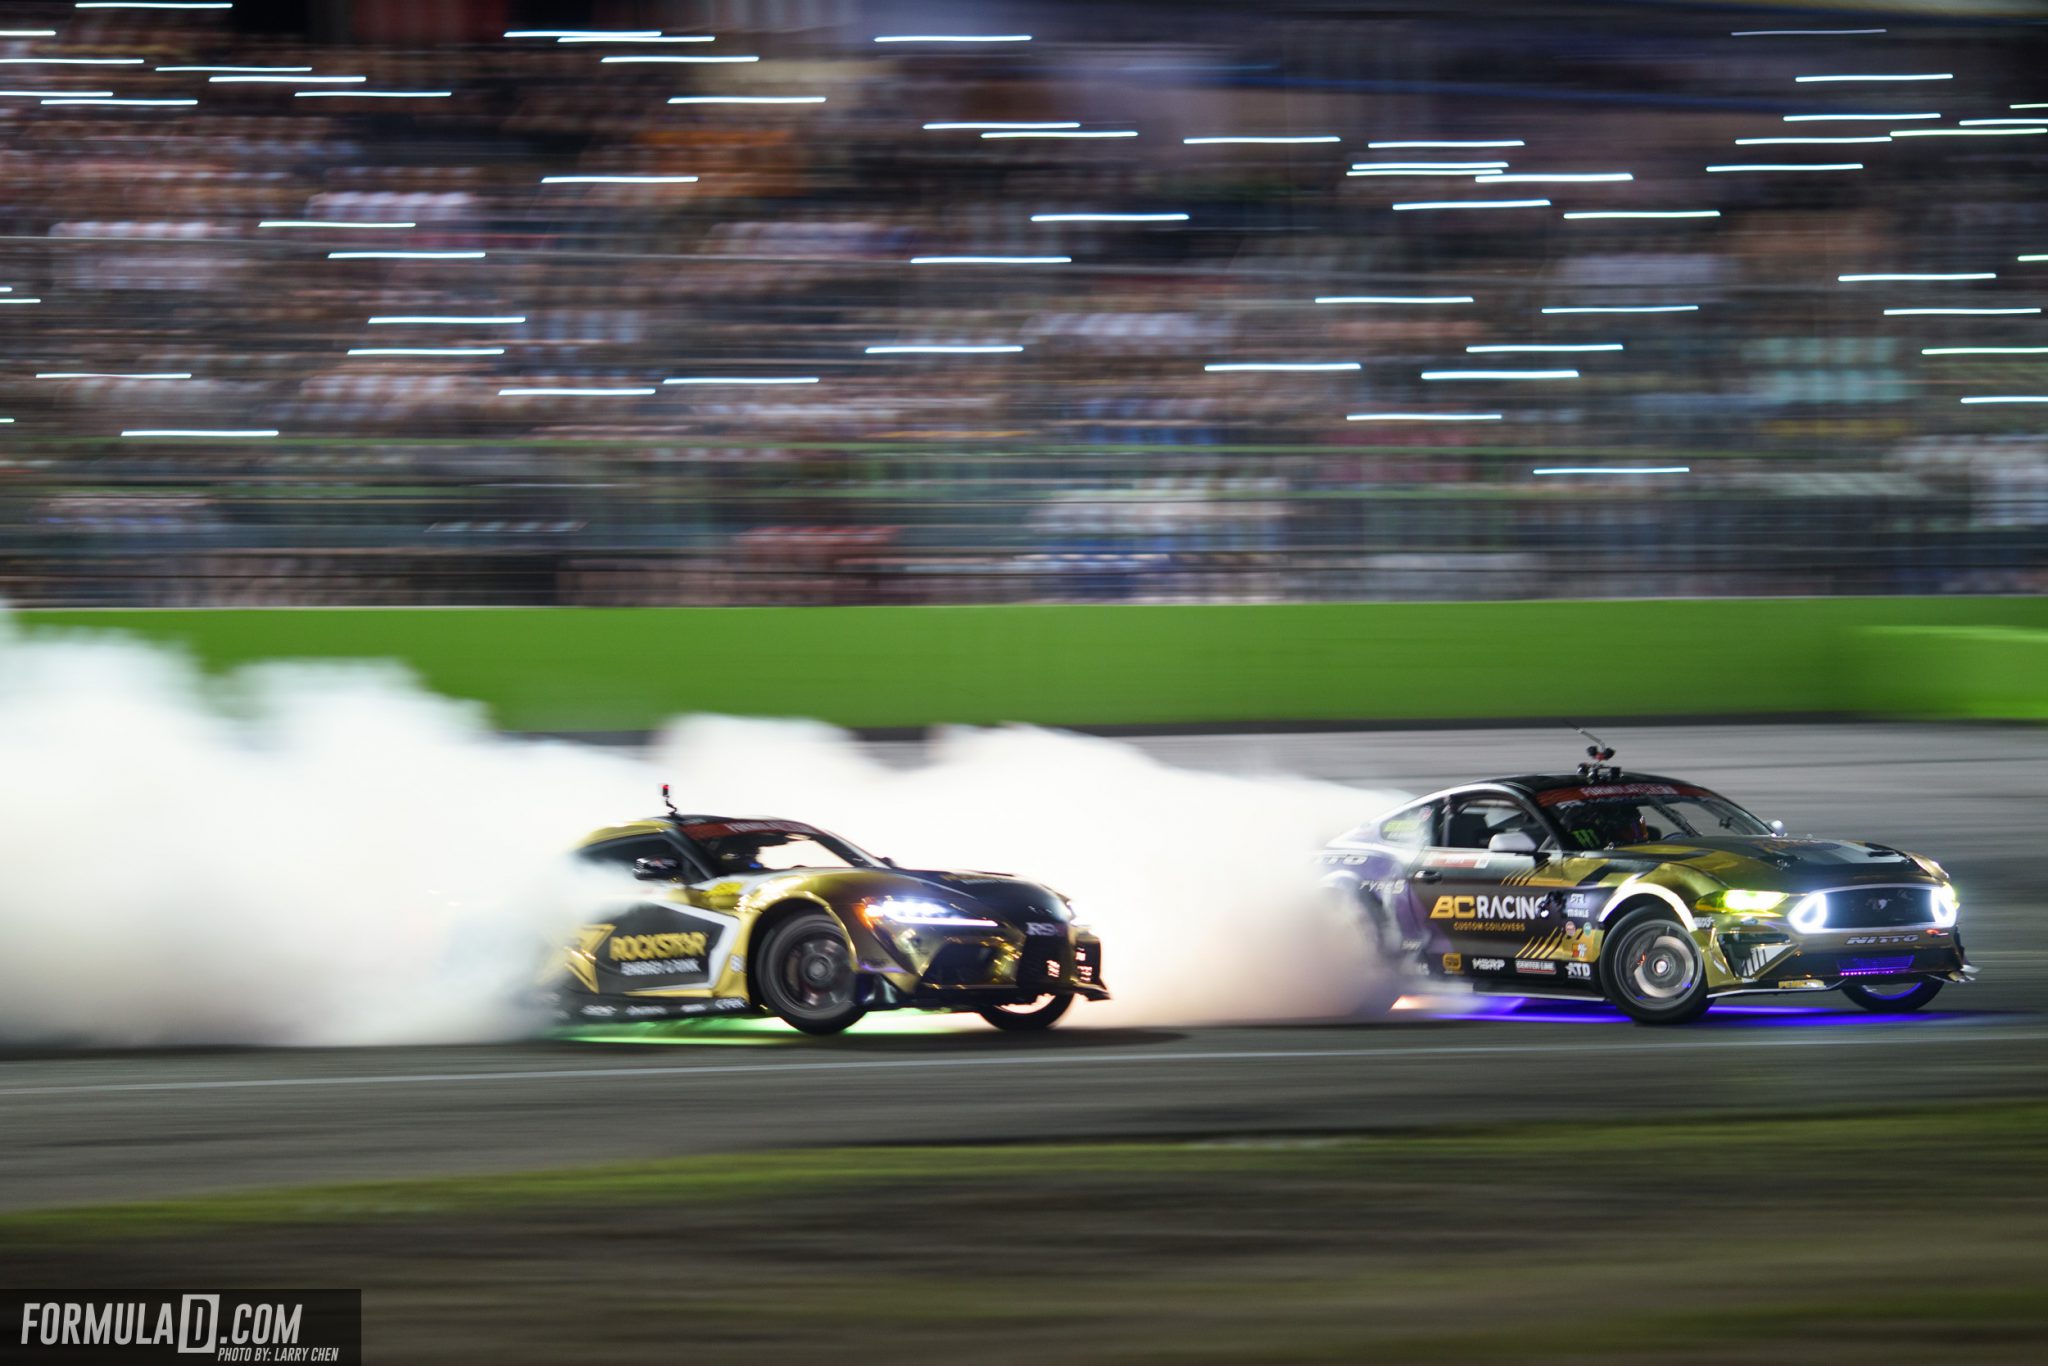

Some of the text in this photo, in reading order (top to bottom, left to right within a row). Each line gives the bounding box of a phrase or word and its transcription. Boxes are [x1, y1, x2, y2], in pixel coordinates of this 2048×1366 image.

[1453, 922, 1484, 931] CUSTOM
[1846, 934, 1919, 945] NITTO
[609, 931, 707, 961] ROCKSTAR
